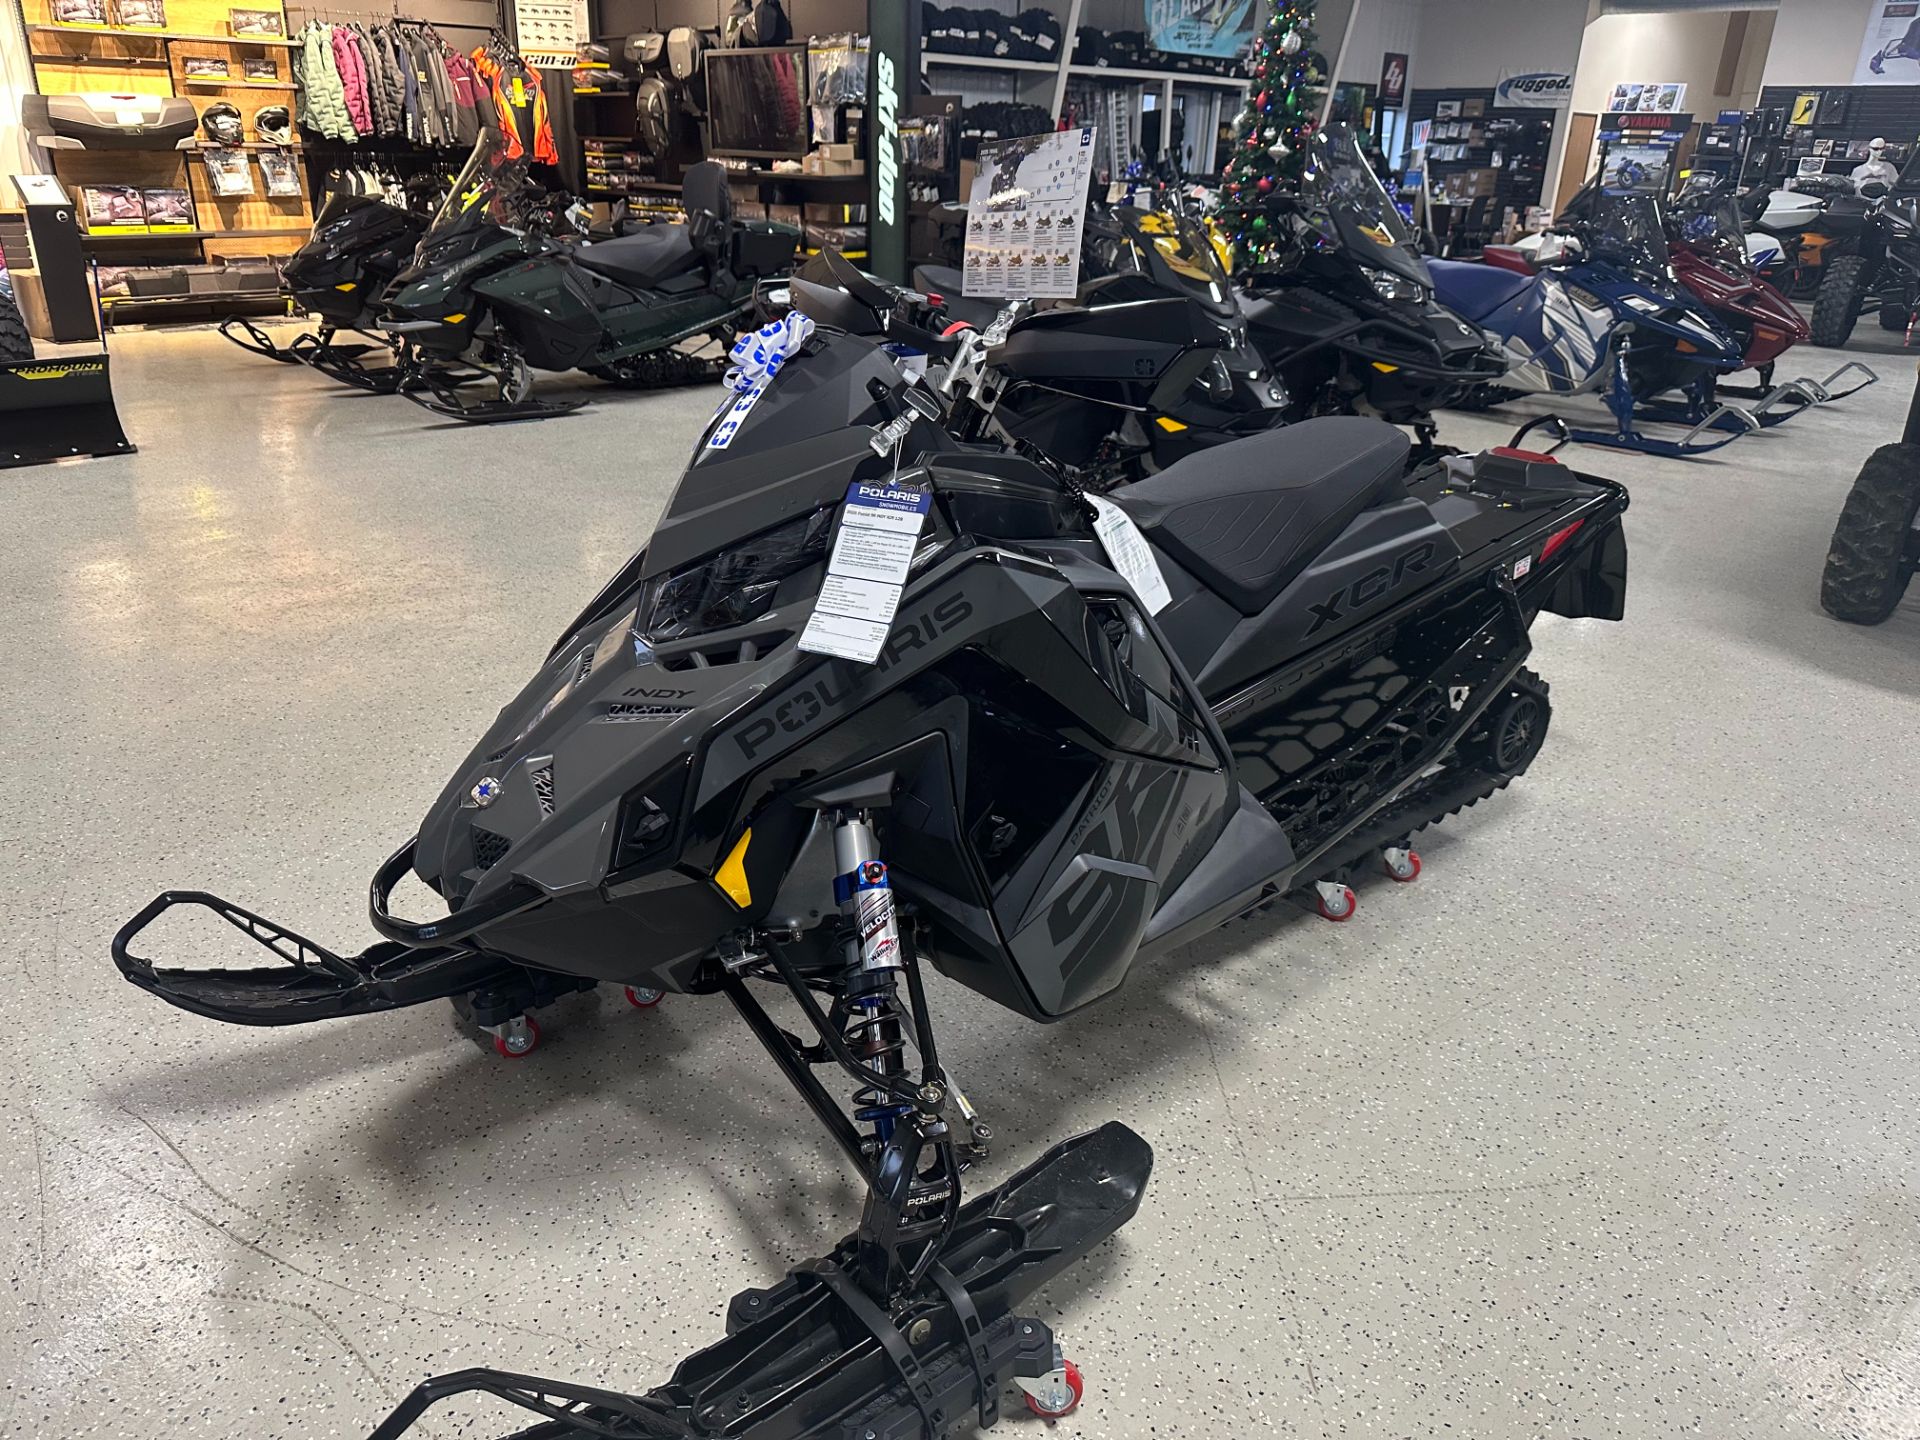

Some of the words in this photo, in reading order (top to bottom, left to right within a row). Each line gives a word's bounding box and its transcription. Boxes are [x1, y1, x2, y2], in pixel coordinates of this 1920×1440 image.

[1629, 115, 1672, 128] YAMAHA
[859, 486, 921, 502] POLARIS
[878, 501, 917, 512] SNOWMOBILES
[1301, 541, 1437, 640] XCR
[621, 687, 696, 698] INDY
[1069, 776, 1113, 846] PATRIOT
[907, 1189, 952, 1207] POLARIS
